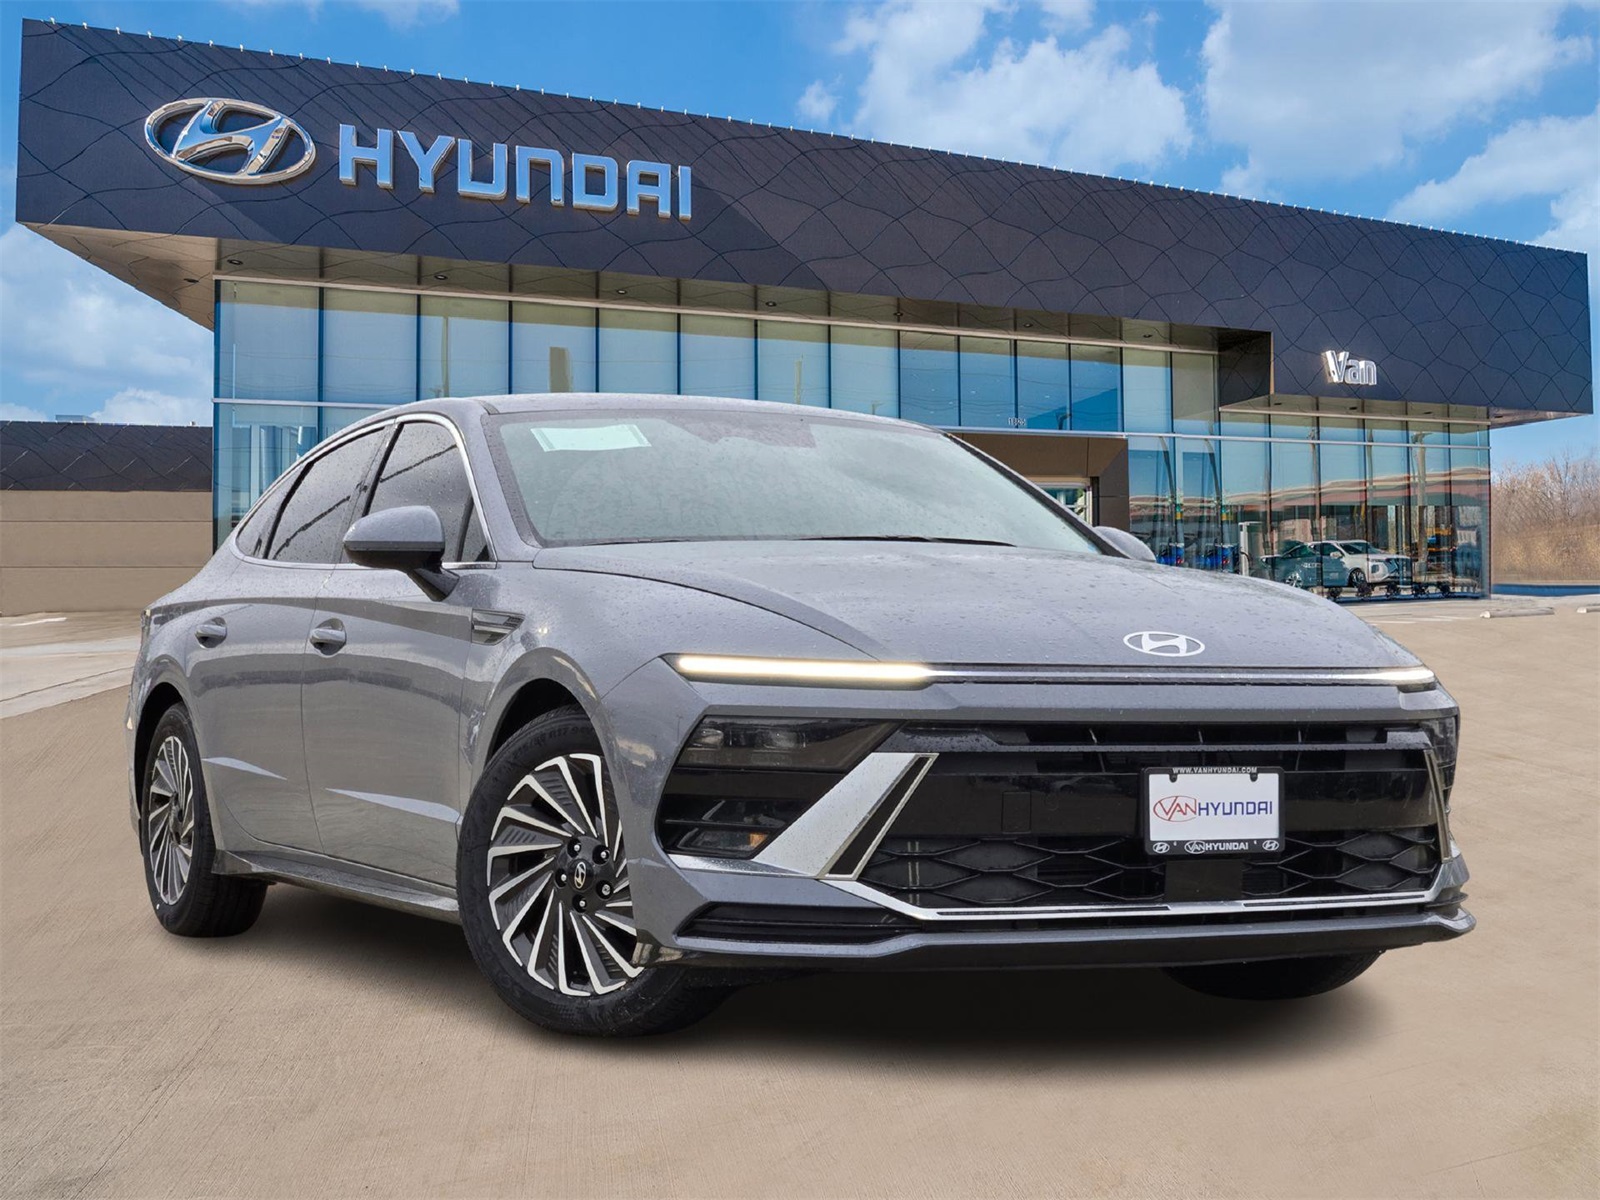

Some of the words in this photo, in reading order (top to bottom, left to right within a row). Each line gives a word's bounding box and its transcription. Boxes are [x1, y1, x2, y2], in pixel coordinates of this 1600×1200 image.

[338, 122, 693, 220] HYUNDAI
[1322, 350, 1377, 386] Van
[1172, 766, 1257, 774] WWW.VANHYUNDAI.COM
